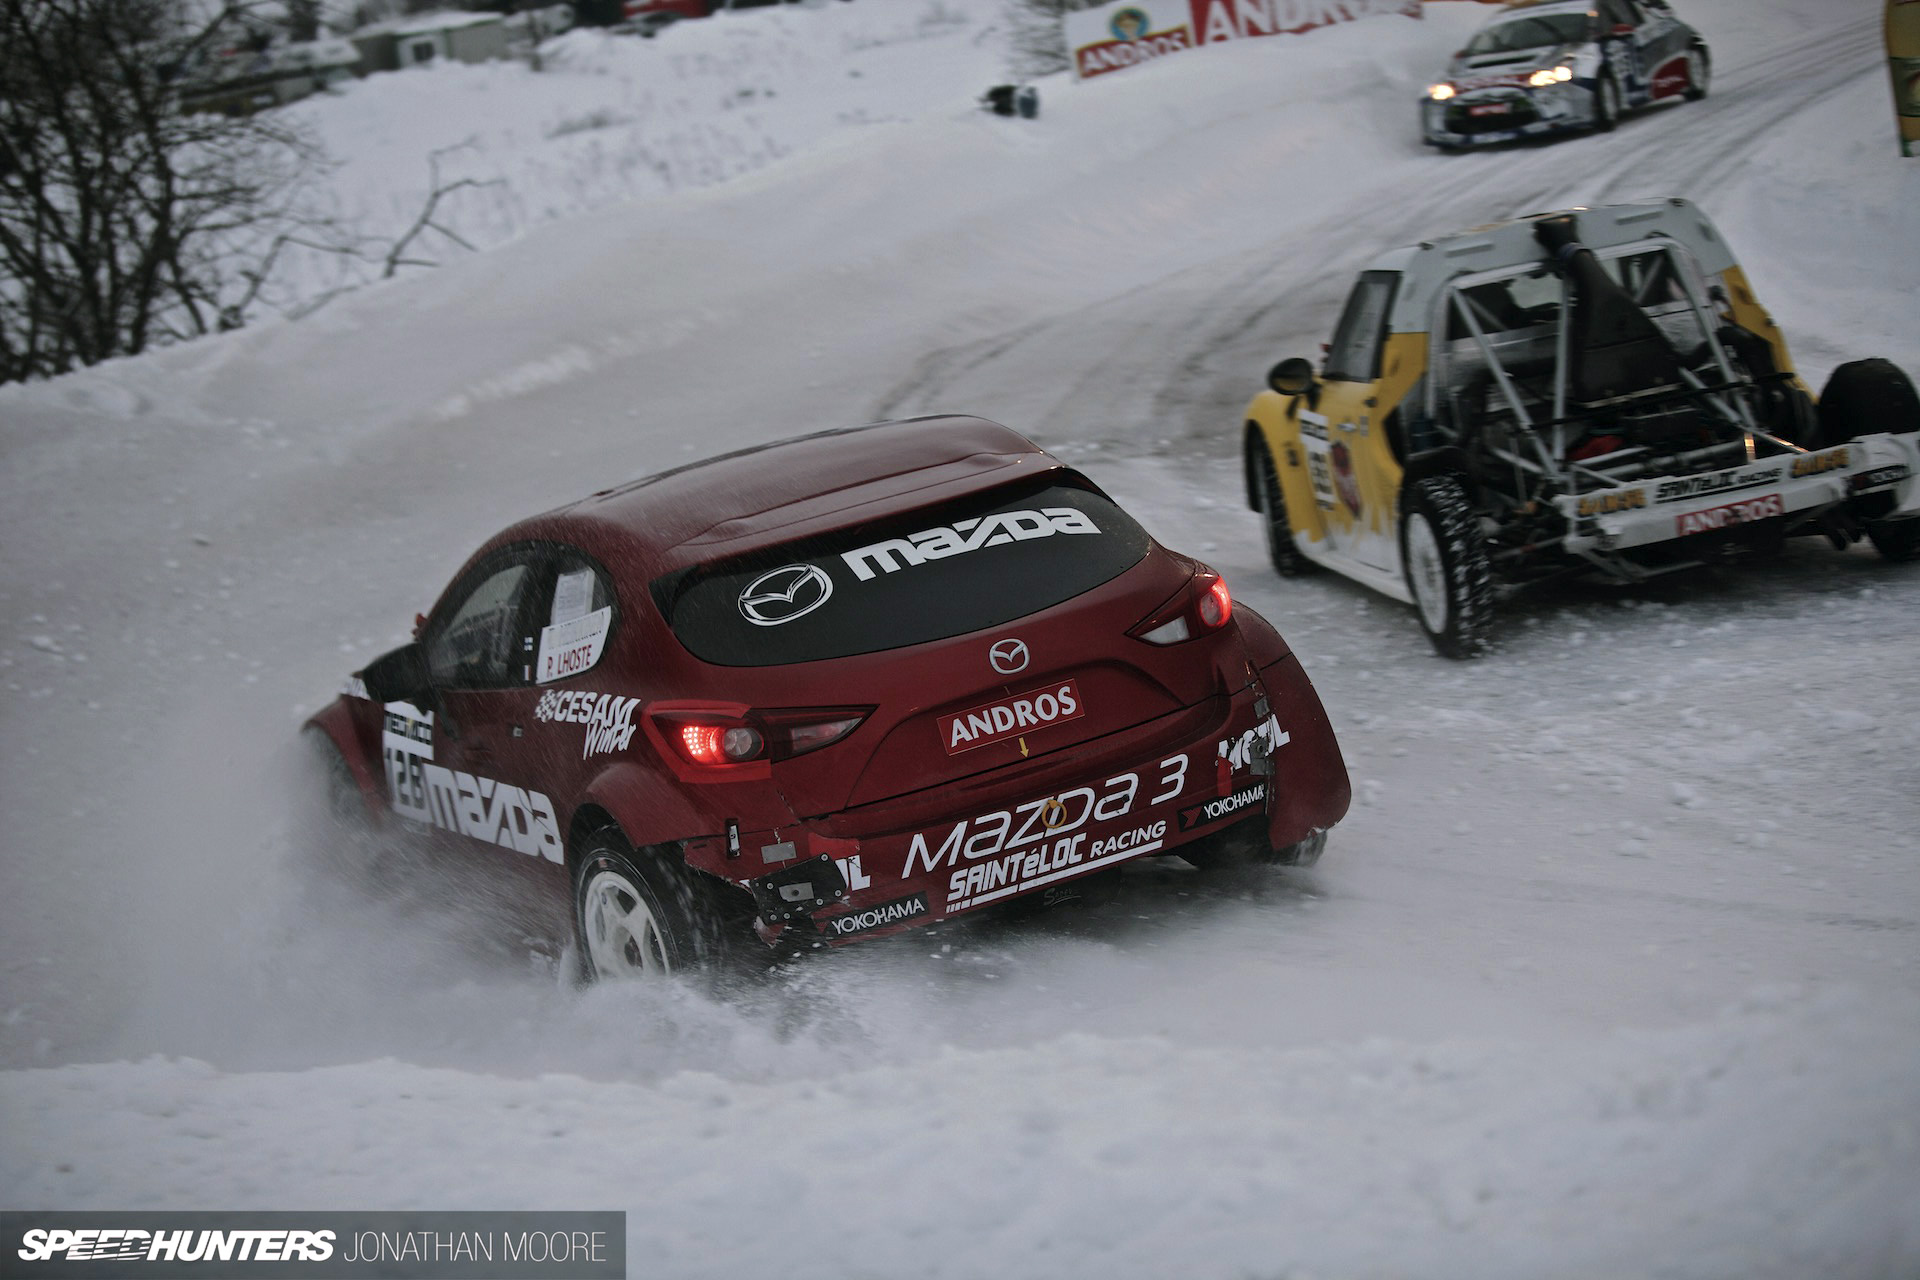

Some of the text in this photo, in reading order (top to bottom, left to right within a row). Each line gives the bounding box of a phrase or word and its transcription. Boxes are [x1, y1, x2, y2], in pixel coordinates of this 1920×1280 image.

[557, 643, 593, 676] LHOSTE
[554, 690, 641, 732] CESAM
[950, 686, 1077, 749] ANDROS
[582, 721, 638, 760] Winter
[1150, 753, 1190, 806] 3
[1203, 785, 1264, 819] YOKOHAMA
[1089, 819, 1166, 859] RACING
[831, 897, 926, 937] YOKOHAMA
